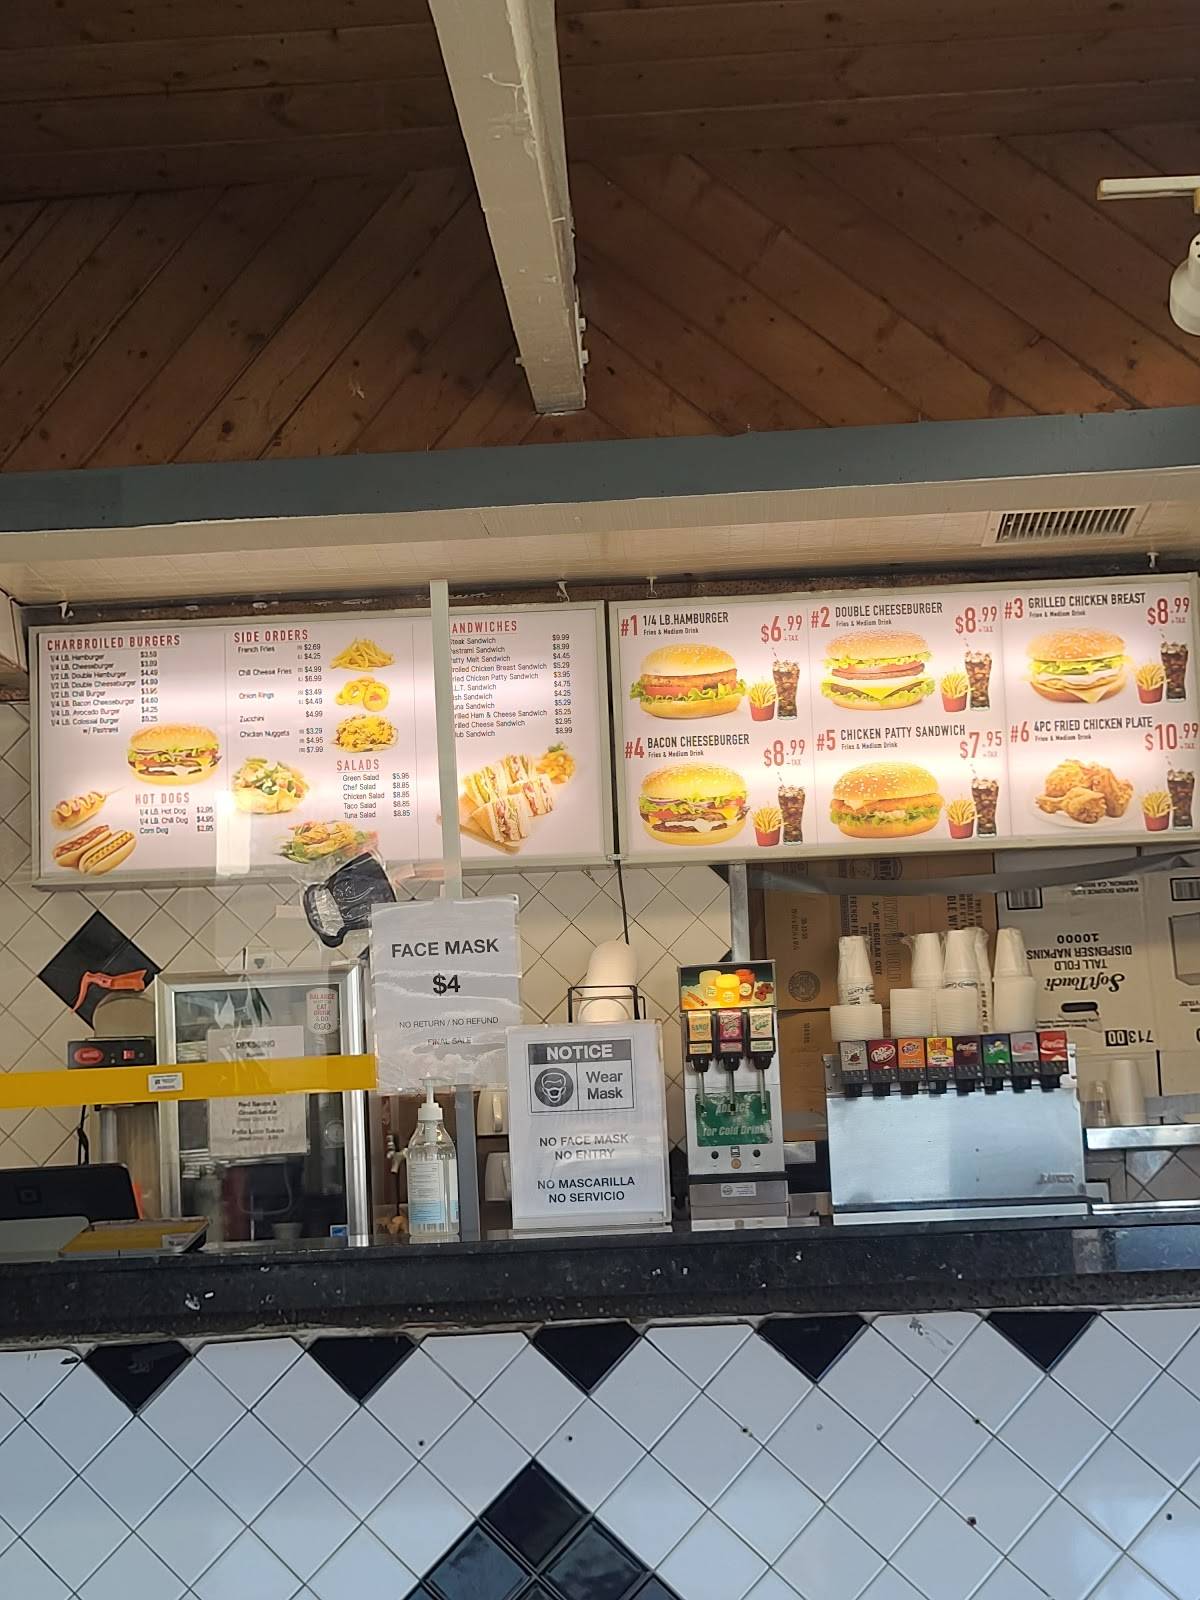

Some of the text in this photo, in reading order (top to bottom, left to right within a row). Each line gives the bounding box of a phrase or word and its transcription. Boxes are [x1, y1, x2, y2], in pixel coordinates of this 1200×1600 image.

[1005, 592, 1190, 625] #3 GRILLED CHICKEN BREAST $8.99
[811, 602, 997, 634] #2 DOUBLE CHEESEBURGER $8.99
[451, 620, 517, 634] ANDWICHES
[621, 614, 638, 637] #1
[643, 615, 656, 627] 1/4
[761, 615, 802, 644] $6.99
[644, 628, 656, 636] Fries
[47, 635, 180, 651] CHARBROILED BURGERS
[234, 629, 308, 643] SIDE ORDERS
[1010, 716, 1199, 751] #6 4PC FRIED CHICKEN PLATE $10.99
[816, 724, 1002, 759] #5 CHICKEN PATTY SANDWICH $7.95
[884, 741, 898, 749] Drink
[624, 733, 805, 767] #4 BACON CHEESEBURGER $8.99
[648, 751, 662, 759] Fries
[668, 750, 688, 758] Medium
[690, 749, 704, 757] Drink
[336, 759, 379, 771] SALADS
[135, 792, 190, 805] HOT DOGS
[391, 938, 500, 958] FACE MASK
[1026, 945, 1132, 960] DISPENSER NAPKINS
[1054, 958, 1108, 971] TALL FOLD
[432, 973, 461, 996] $4
[400, 1021, 412, 1029] NO
[413, 1019, 446, 1028] RETURN
[451, 1018, 464, 1026] NO
[467, 1016, 499, 1025] REFUND
[546, 1043, 614, 1061] NOTICE
[586, 1071, 623, 1084] Wear
[587, 1087, 623, 1100] Mask
[539, 1134, 629, 1147] NO FACE MASK
[555, 1148, 615, 1161] NO ENTRY
[537, 1176, 635, 1190] NO MASCARILLA
[548, 1191, 625, 1204] NO SERVICIO
